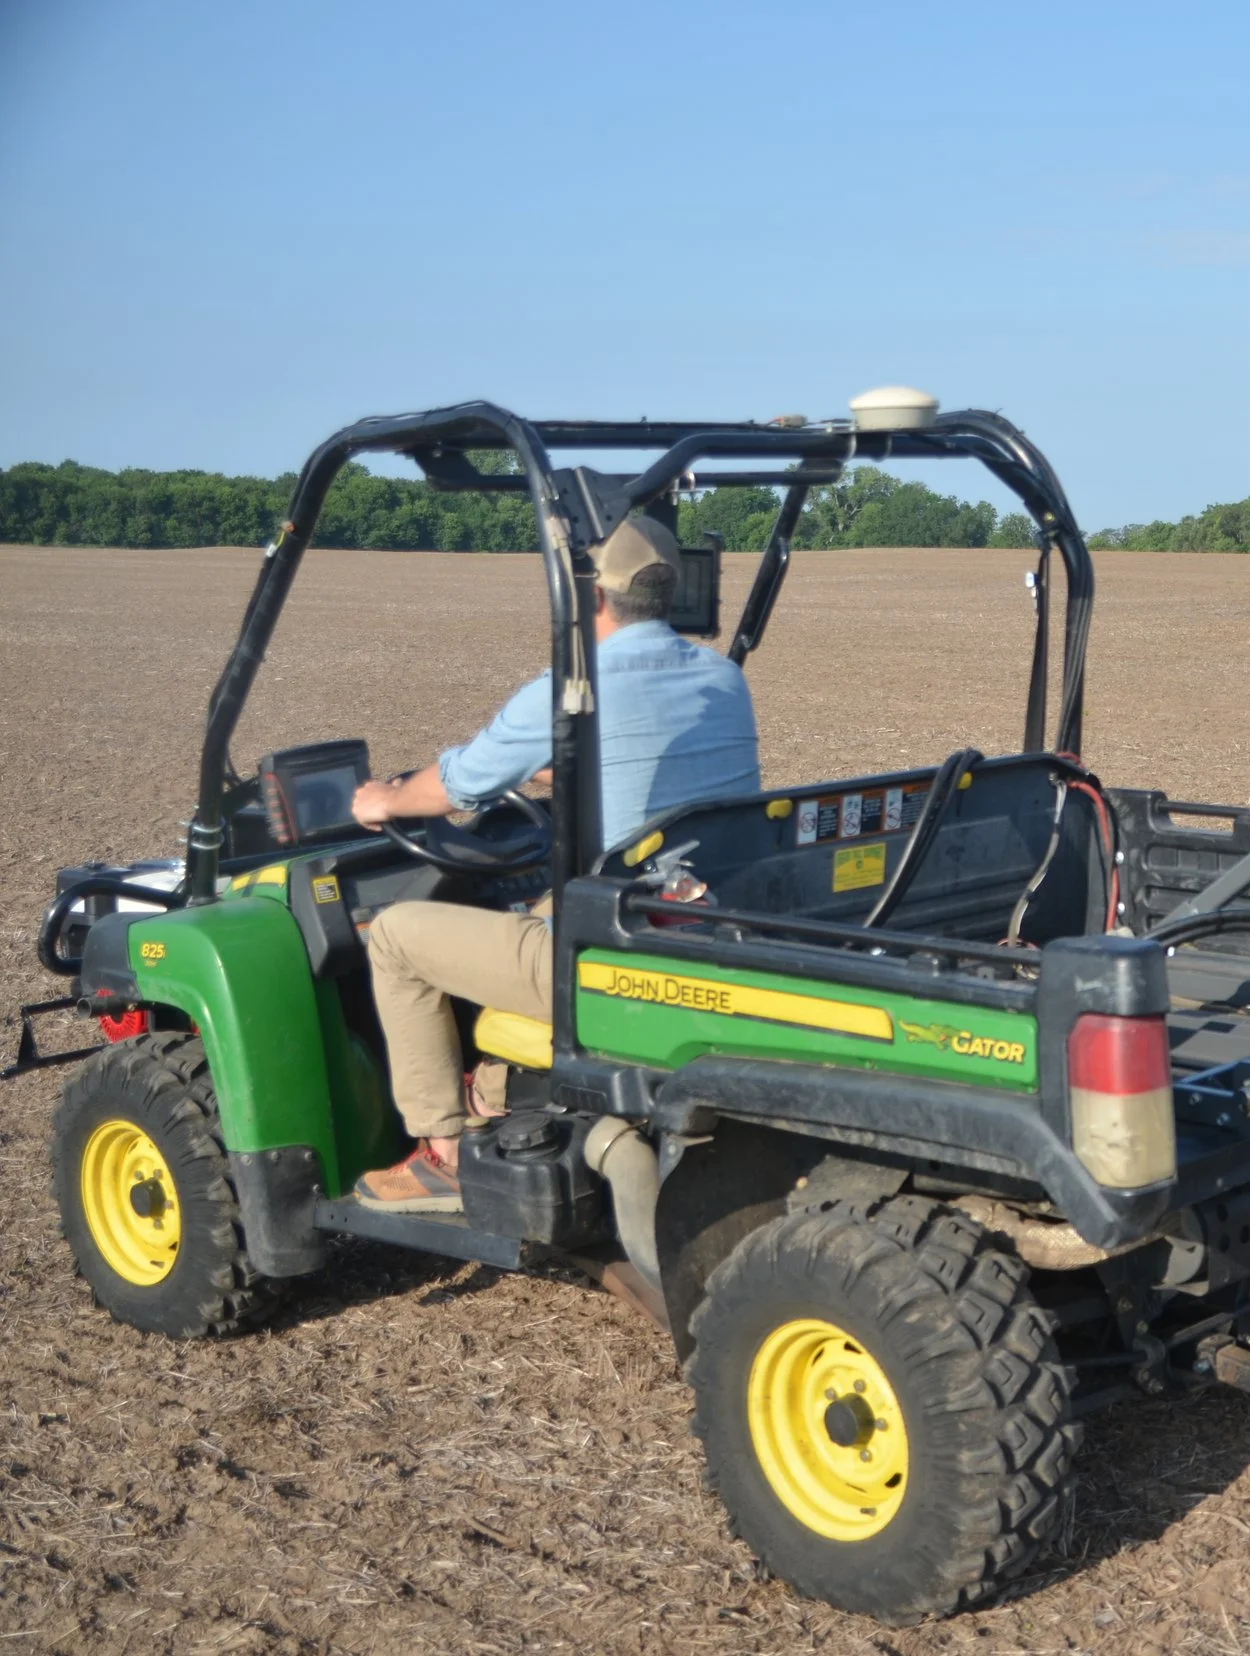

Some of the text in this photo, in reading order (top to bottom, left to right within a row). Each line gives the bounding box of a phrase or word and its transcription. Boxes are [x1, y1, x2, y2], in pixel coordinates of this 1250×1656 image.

[606, 970, 731, 1009] JOHN DEERE
[951, 1031, 1024, 1063] GATOR
